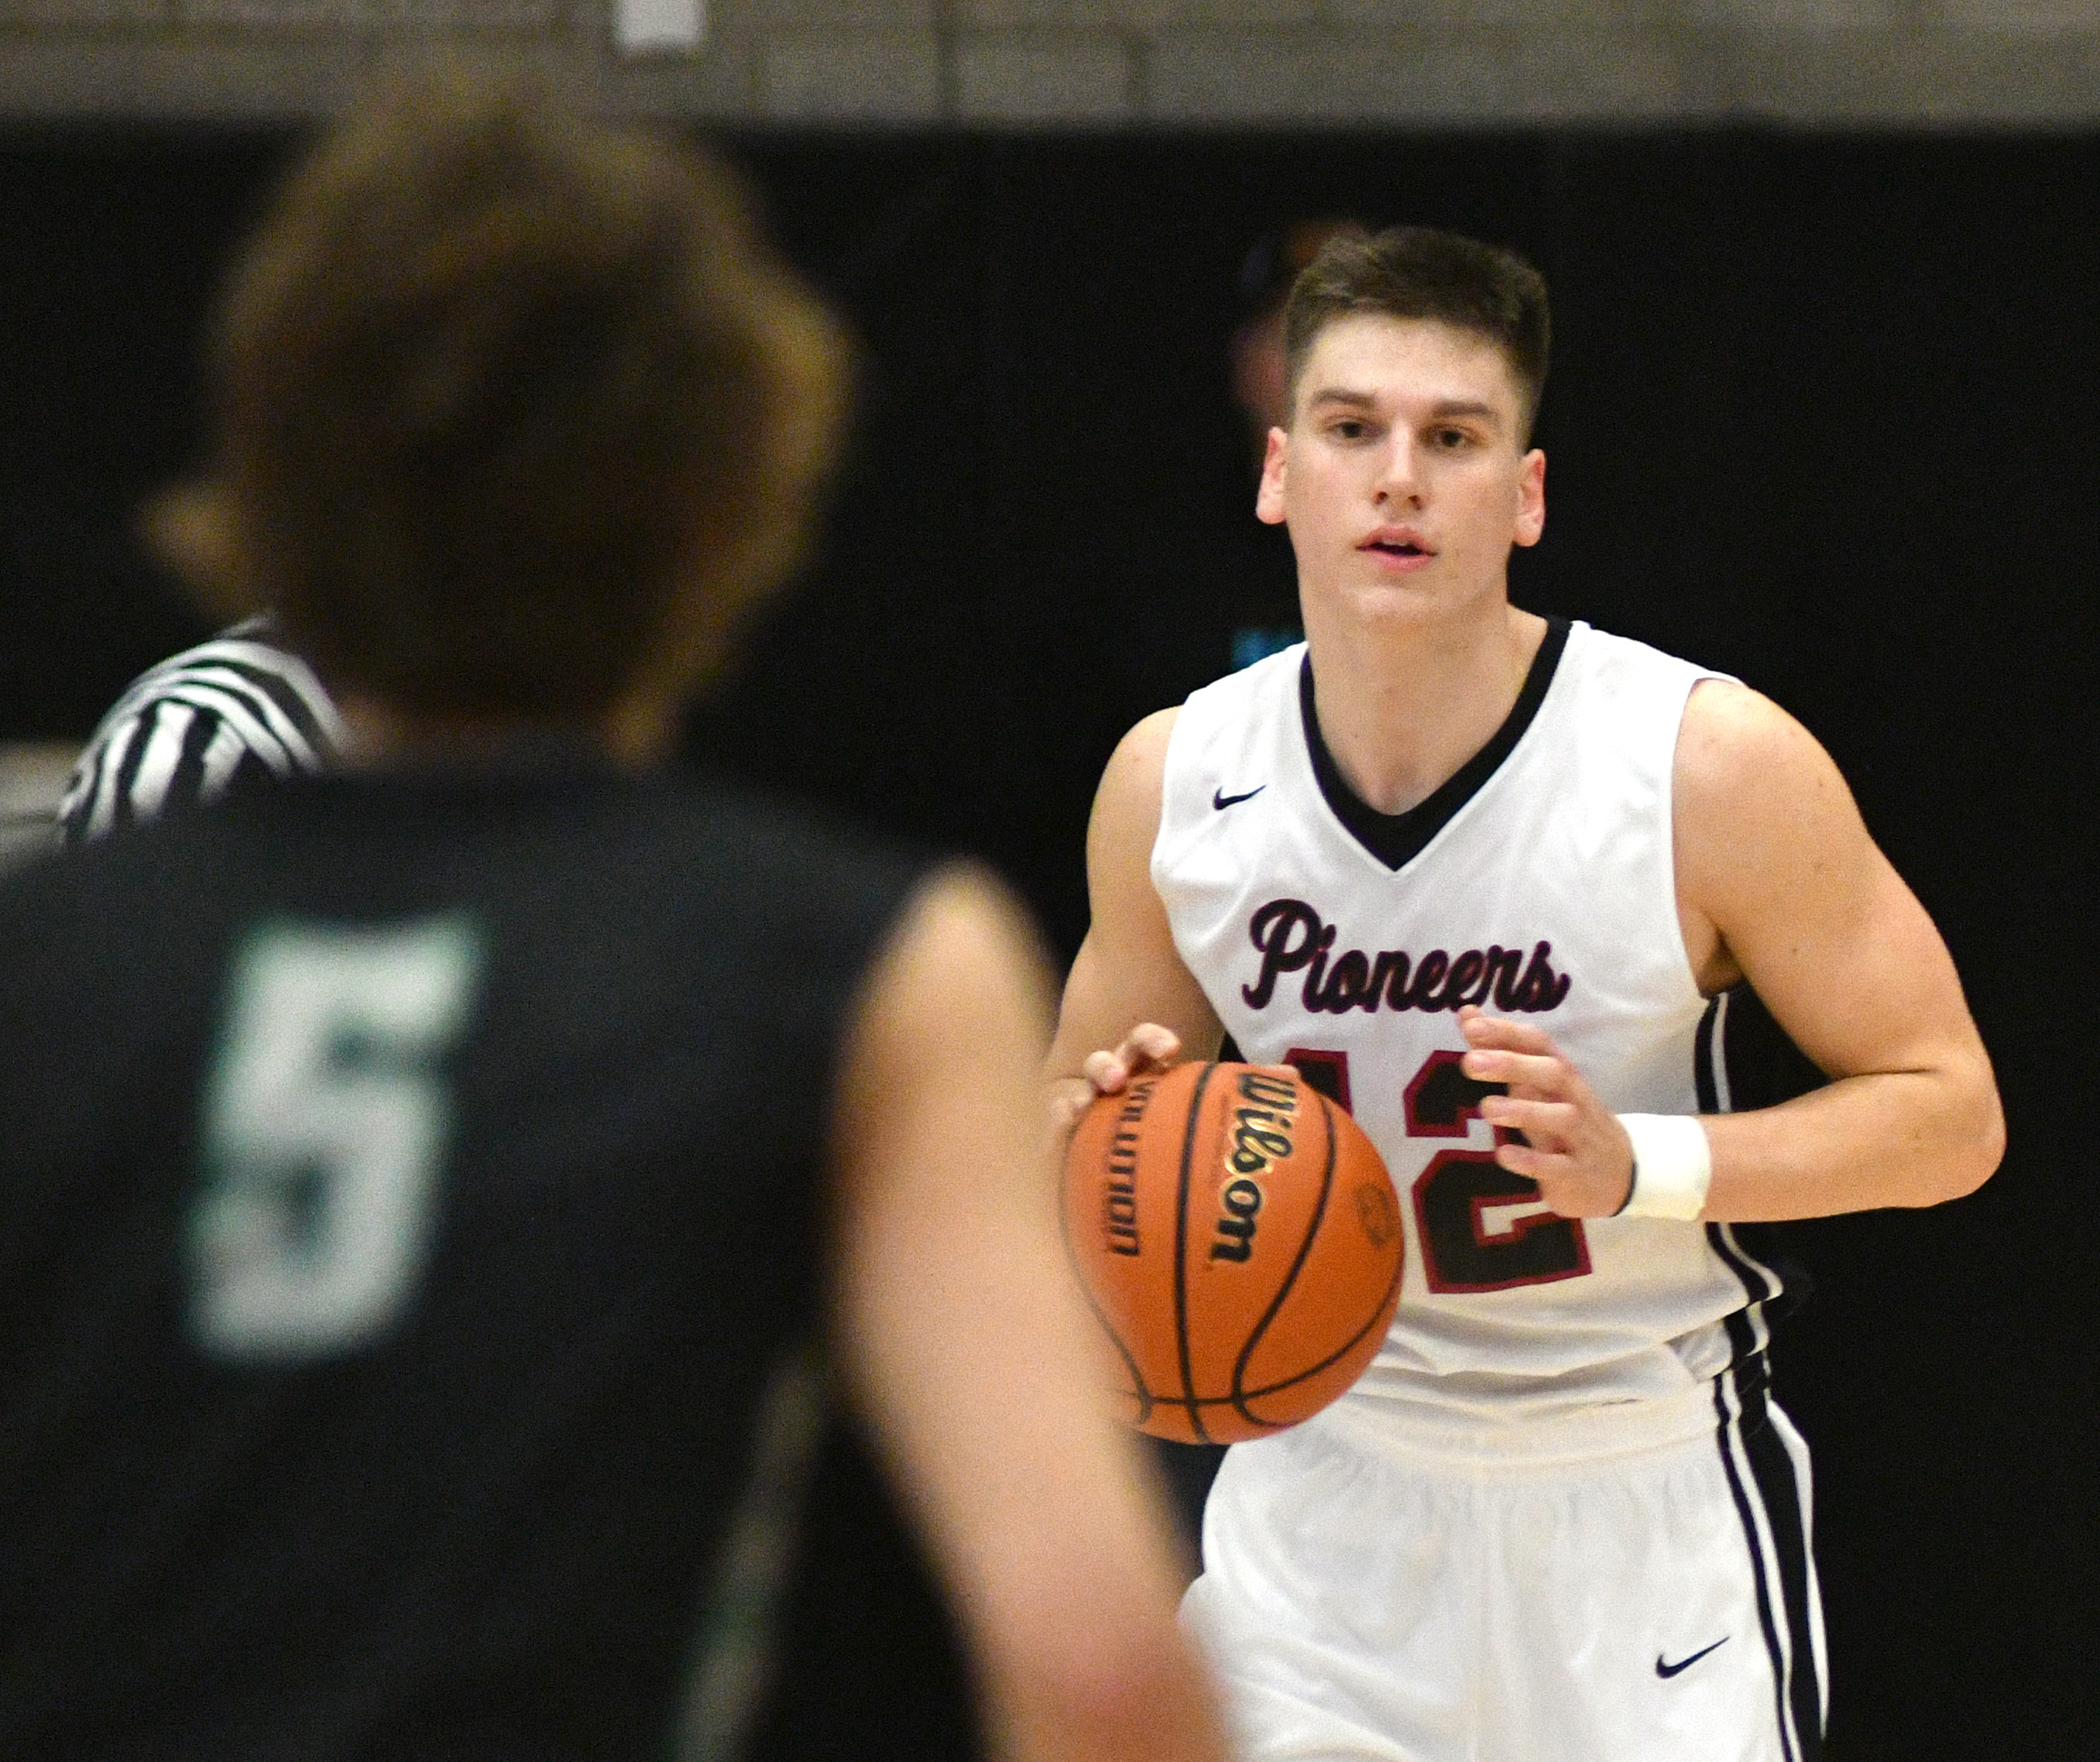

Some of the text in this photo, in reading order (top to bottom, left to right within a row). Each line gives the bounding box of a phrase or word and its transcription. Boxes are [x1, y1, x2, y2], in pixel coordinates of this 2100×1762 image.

[1241, 898, 1571, 1014] Pioneers
[192, 914, 483, 1356] 5
[1210, 1072, 1298, 1263] Wilson
[1283, 1047, 1592, 1294] 2
